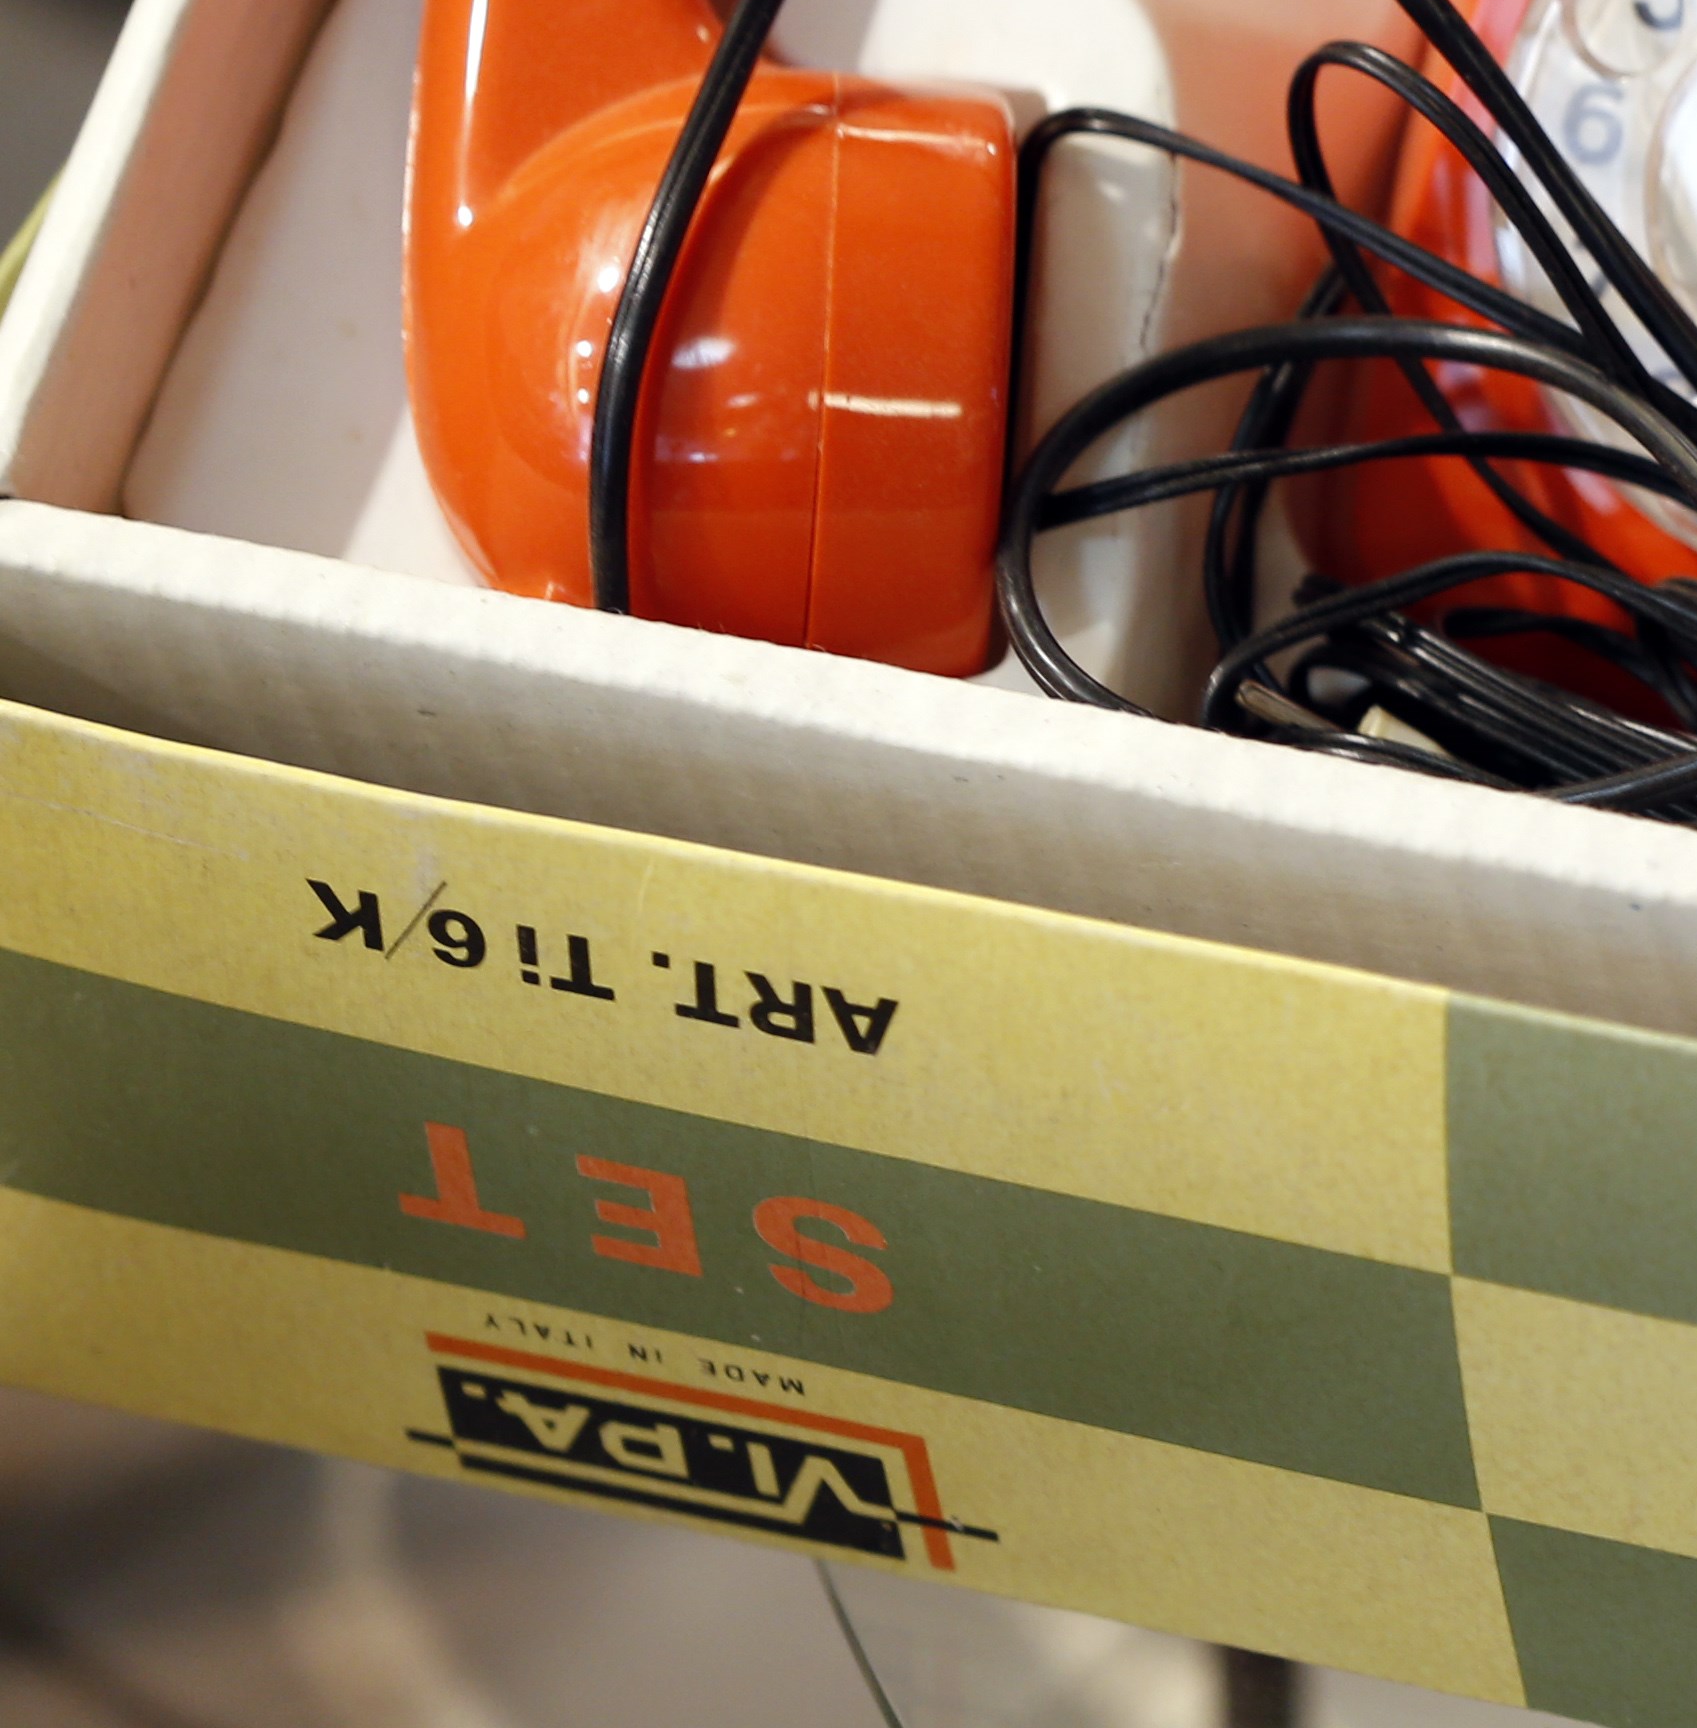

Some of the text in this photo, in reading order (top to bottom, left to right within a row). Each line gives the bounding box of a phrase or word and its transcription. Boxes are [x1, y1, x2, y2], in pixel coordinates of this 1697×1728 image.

[1562, 80, 1625, 168] 6
[651, 952, 900, 1056] ART.
[400, 1121, 893, 1314] SET
[484, 1312, 806, 1397] MADE IN ITALY
[456, 1377, 898, 1528] VI.PA.
